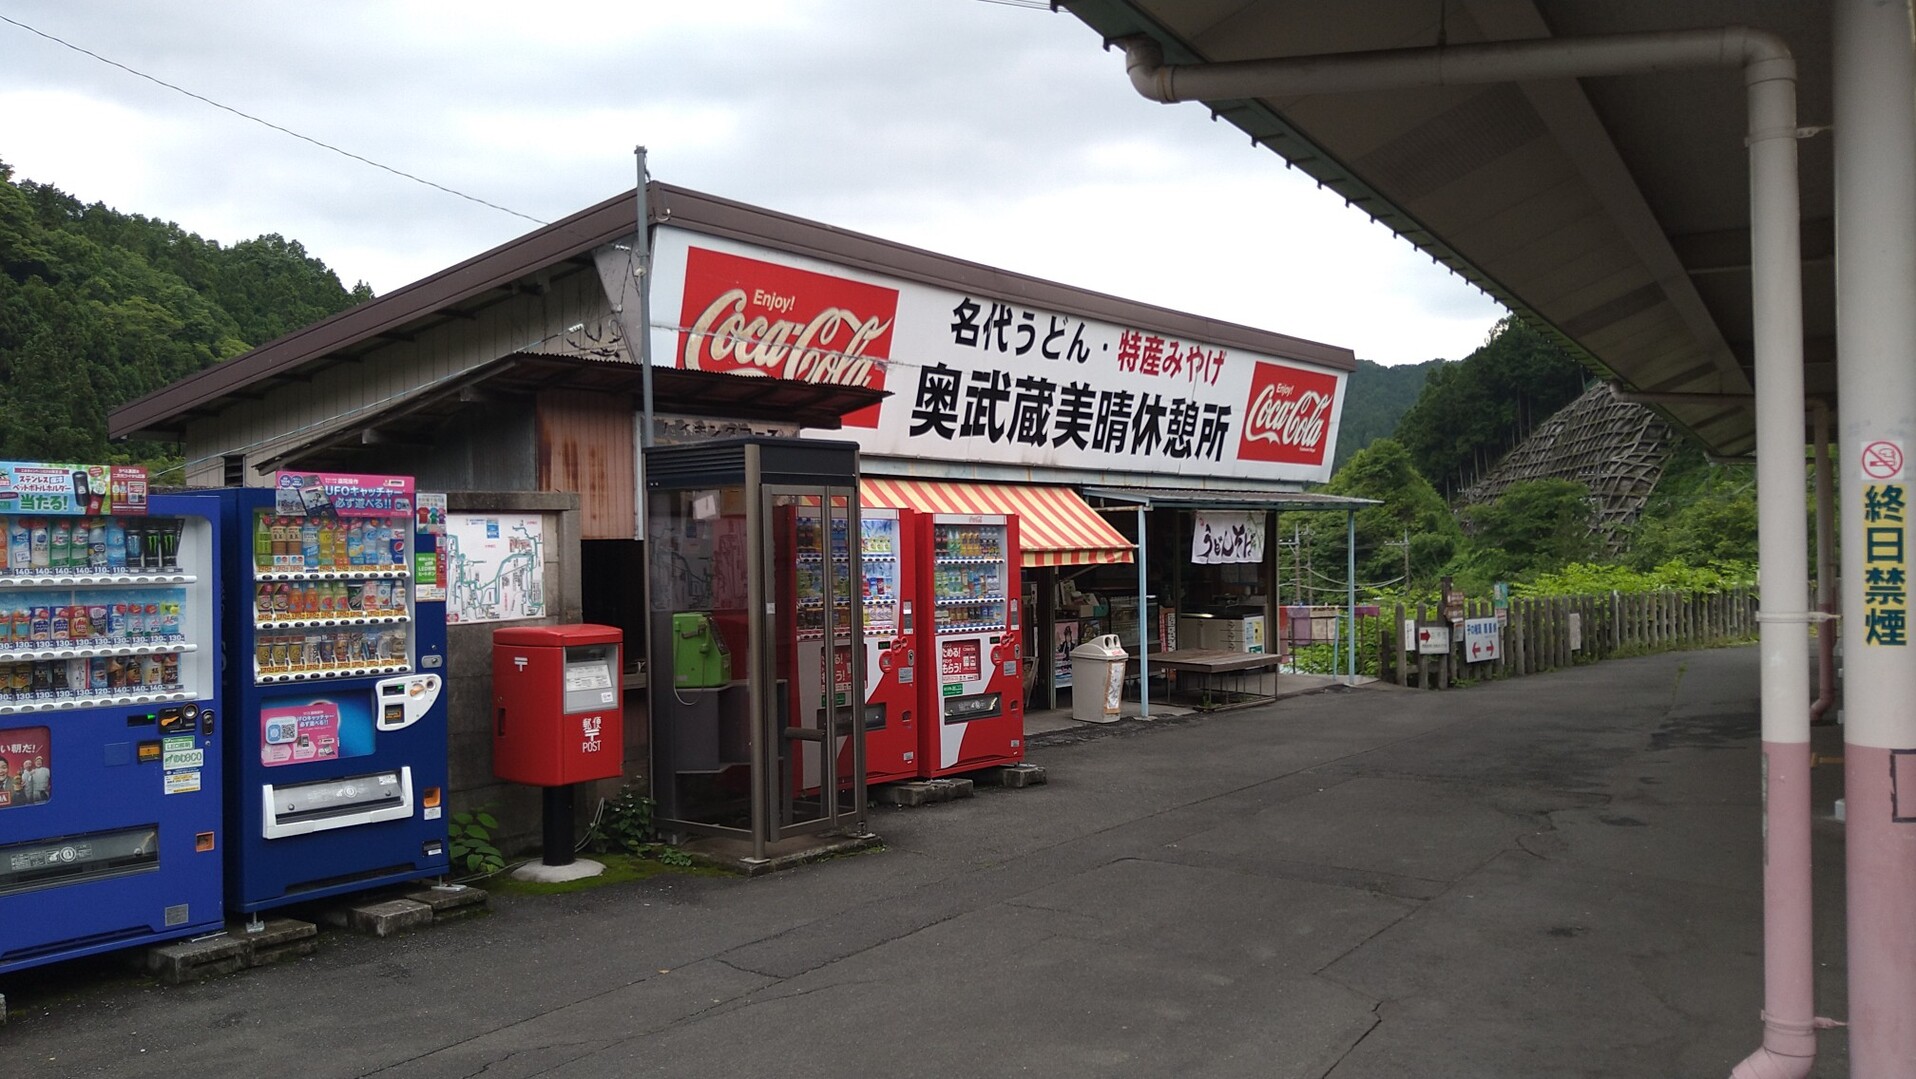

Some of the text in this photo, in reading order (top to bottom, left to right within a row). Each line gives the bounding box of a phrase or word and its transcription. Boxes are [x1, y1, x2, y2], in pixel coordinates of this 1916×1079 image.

[753, 289, 795, 313] Enjoy!
[1276, 383, 1294, 396] Enjoy!
[909, 362, 1232, 462] 奥武蔵美晴休憩所
[12, 484, 71, 492] ペットボトルホルダー
[325, 486, 403, 497] UFOキャッチャー
[21, 494, 68, 511] 当たる!
[335, 498, 391, 508] 必ず遊べる!!
[1864, 484, 1907, 647] 終日禁煙
[583, 716, 601, 731] 郵便
[582, 740, 601, 753] POST
